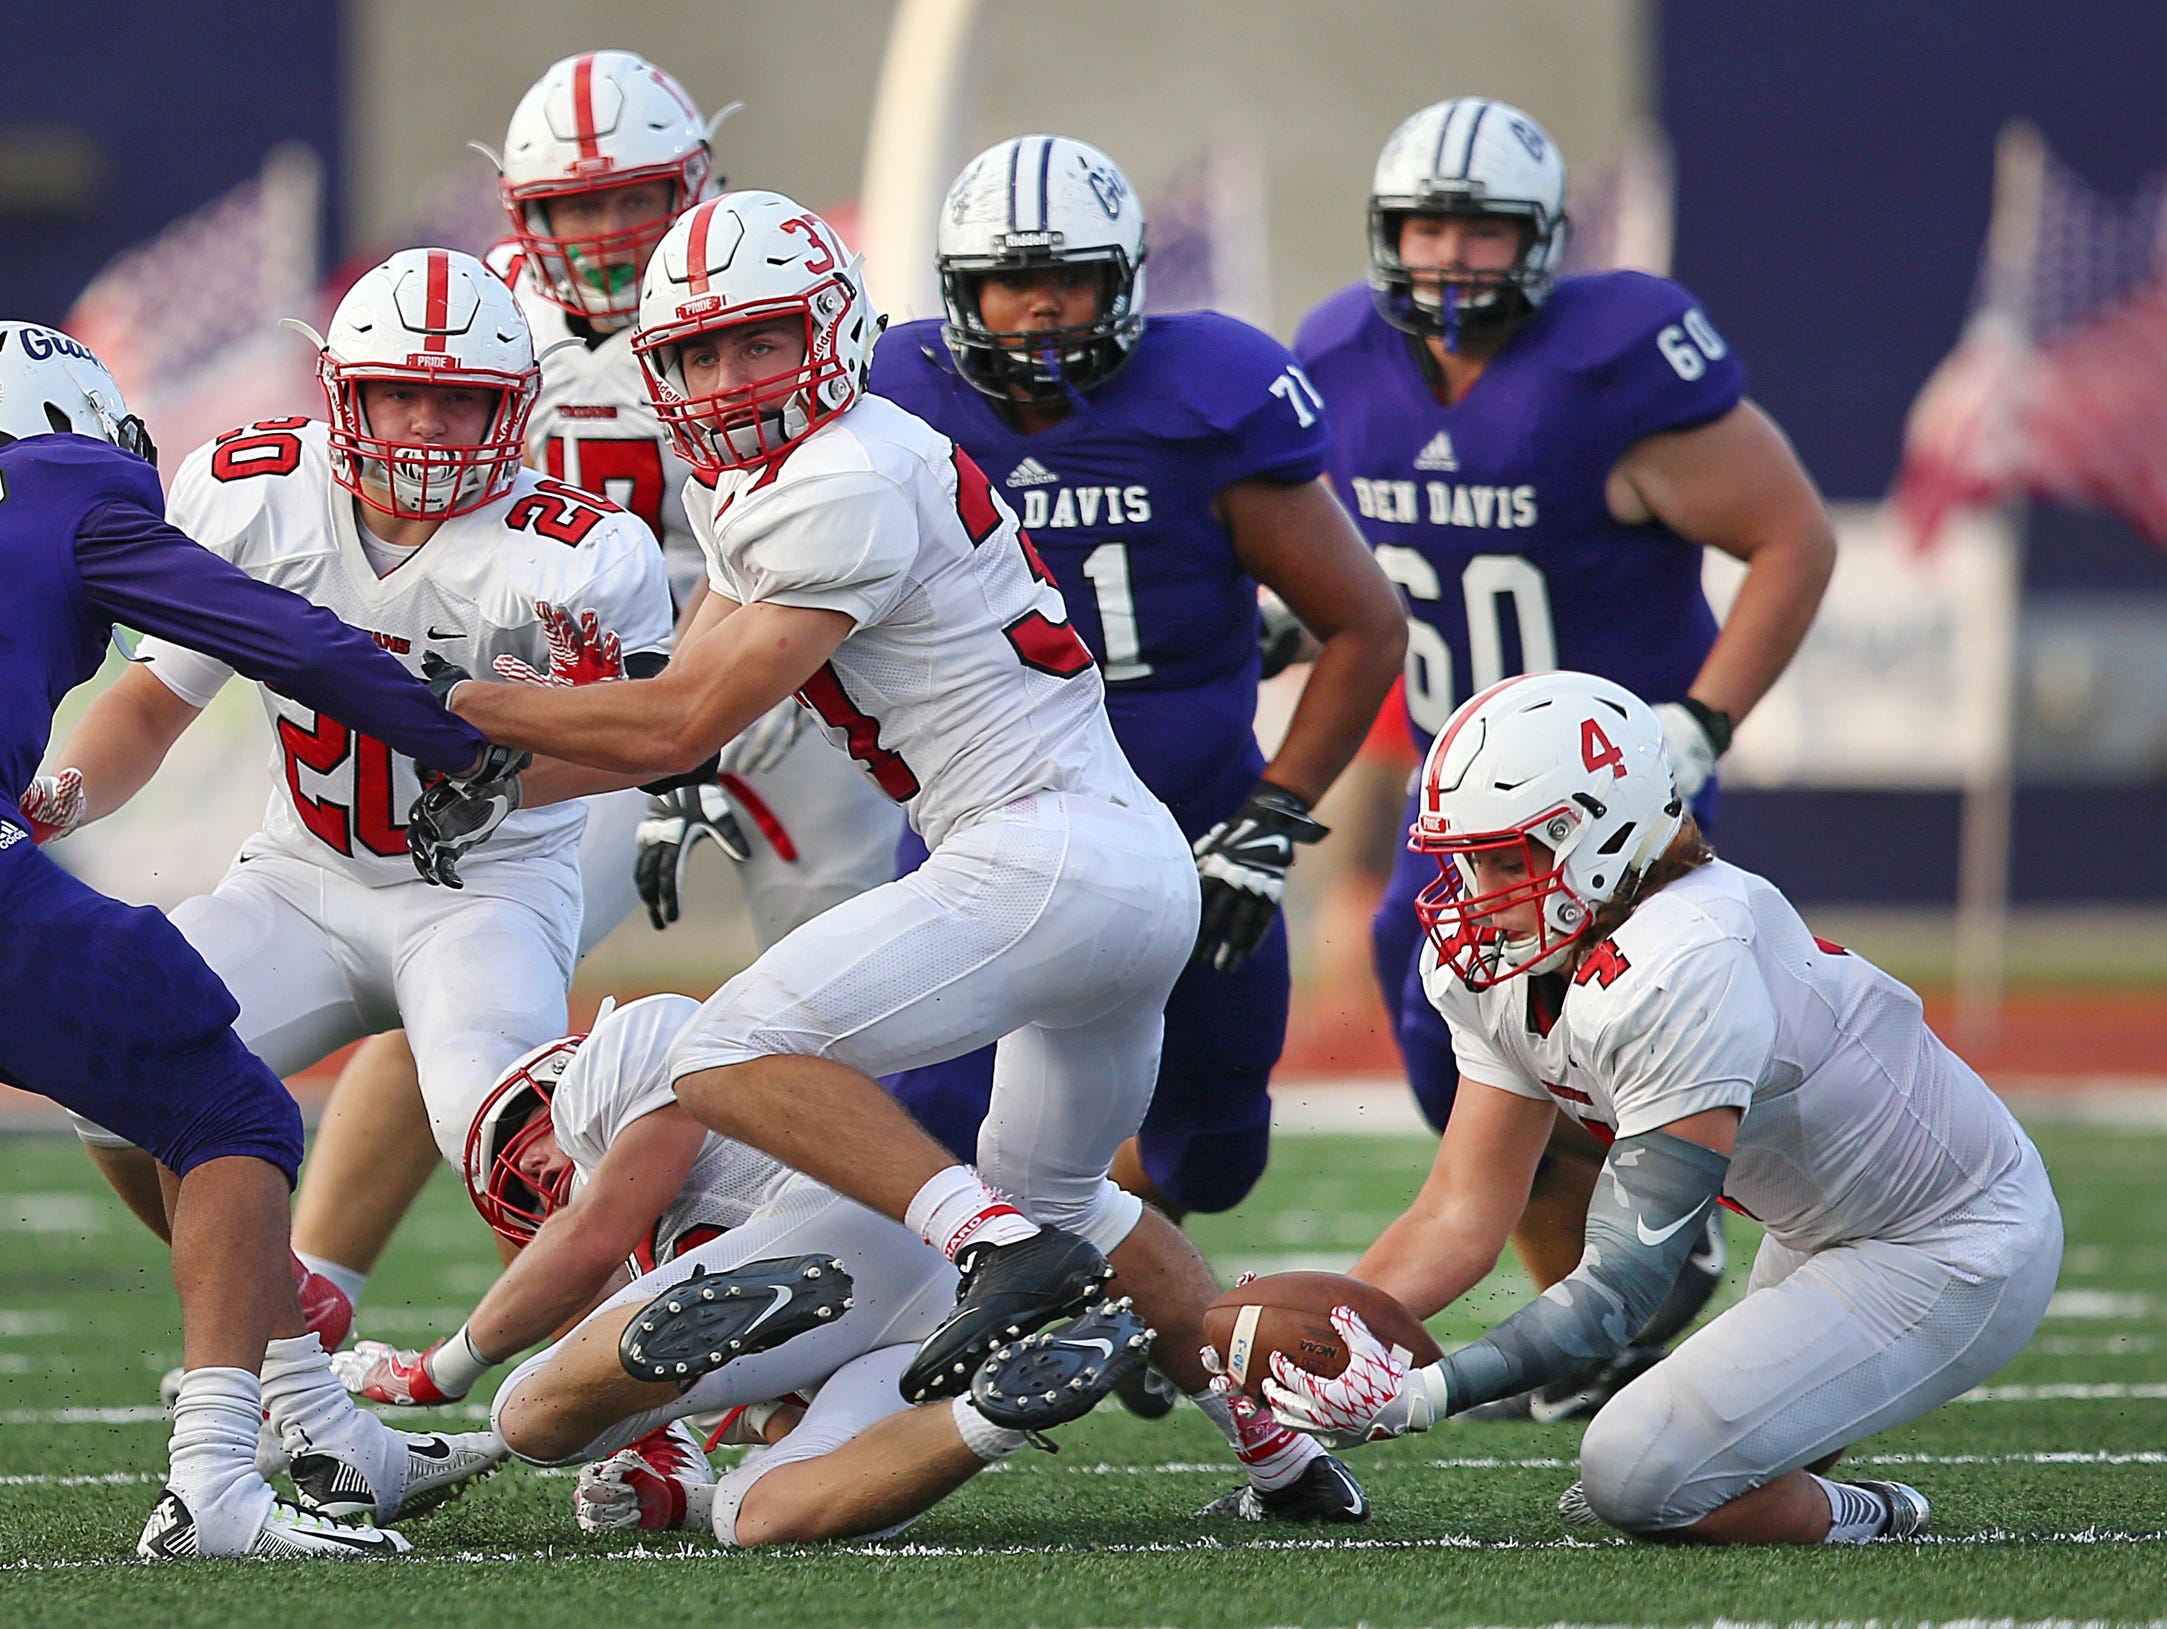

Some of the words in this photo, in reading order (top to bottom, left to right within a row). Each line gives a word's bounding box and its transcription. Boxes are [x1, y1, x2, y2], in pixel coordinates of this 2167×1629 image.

[684, 298, 714, 315] PRIDE
[417, 355, 448, 368] PRIDE
[1657, 307, 1728, 381] 60
[1268, 364, 1324, 428] 71
[1023, 485, 1152, 529] DAVIS
[1351, 476, 1418, 524] BEN
[1426, 481, 1539, 529] DAVIS
[1374, 543, 1558, 736] 60
[1581, 718, 1627, 779] 4
[1422, 816, 1442, 832] PRIDE
[945, 1216, 982, 1261] HARD
